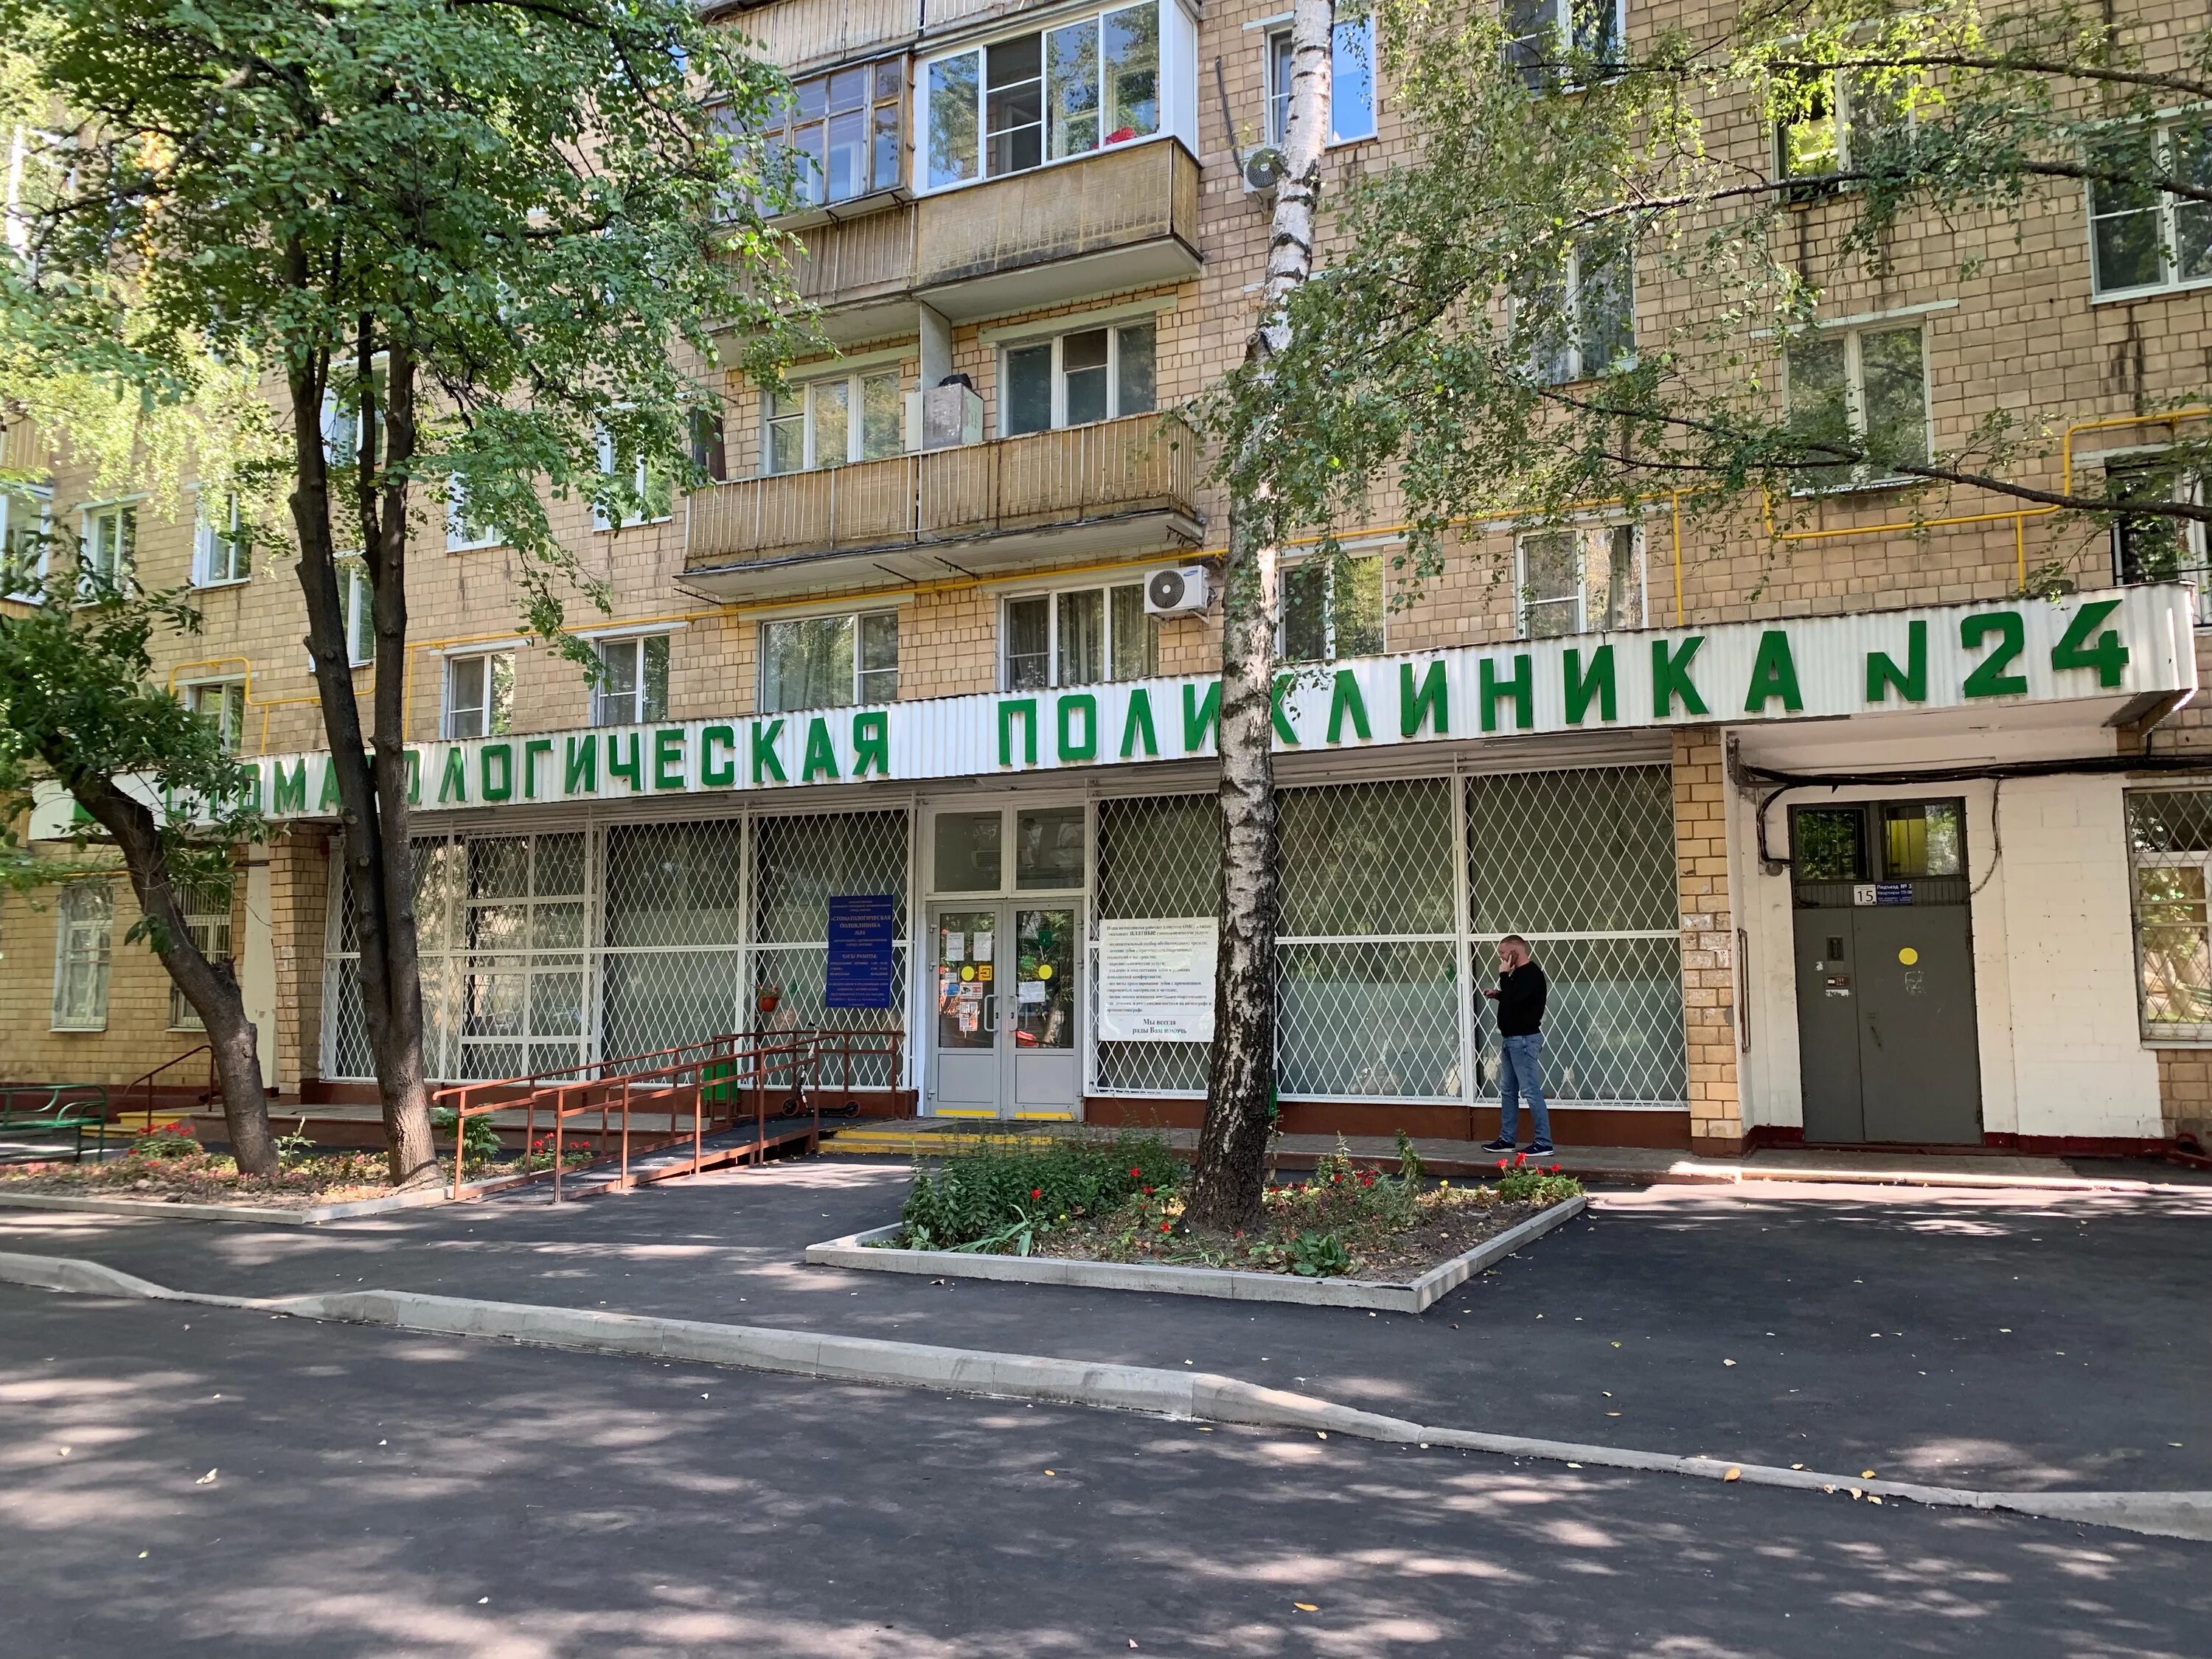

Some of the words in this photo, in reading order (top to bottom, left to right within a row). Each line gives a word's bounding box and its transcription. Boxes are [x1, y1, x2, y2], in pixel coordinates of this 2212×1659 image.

[165, 711, 889, 827] СОМАОЛОГИЧЕСКАЯ
[998, 630, 1804, 766] ПОЛИКЛИНИКА
[1857, 890, 1874, 902] 15
